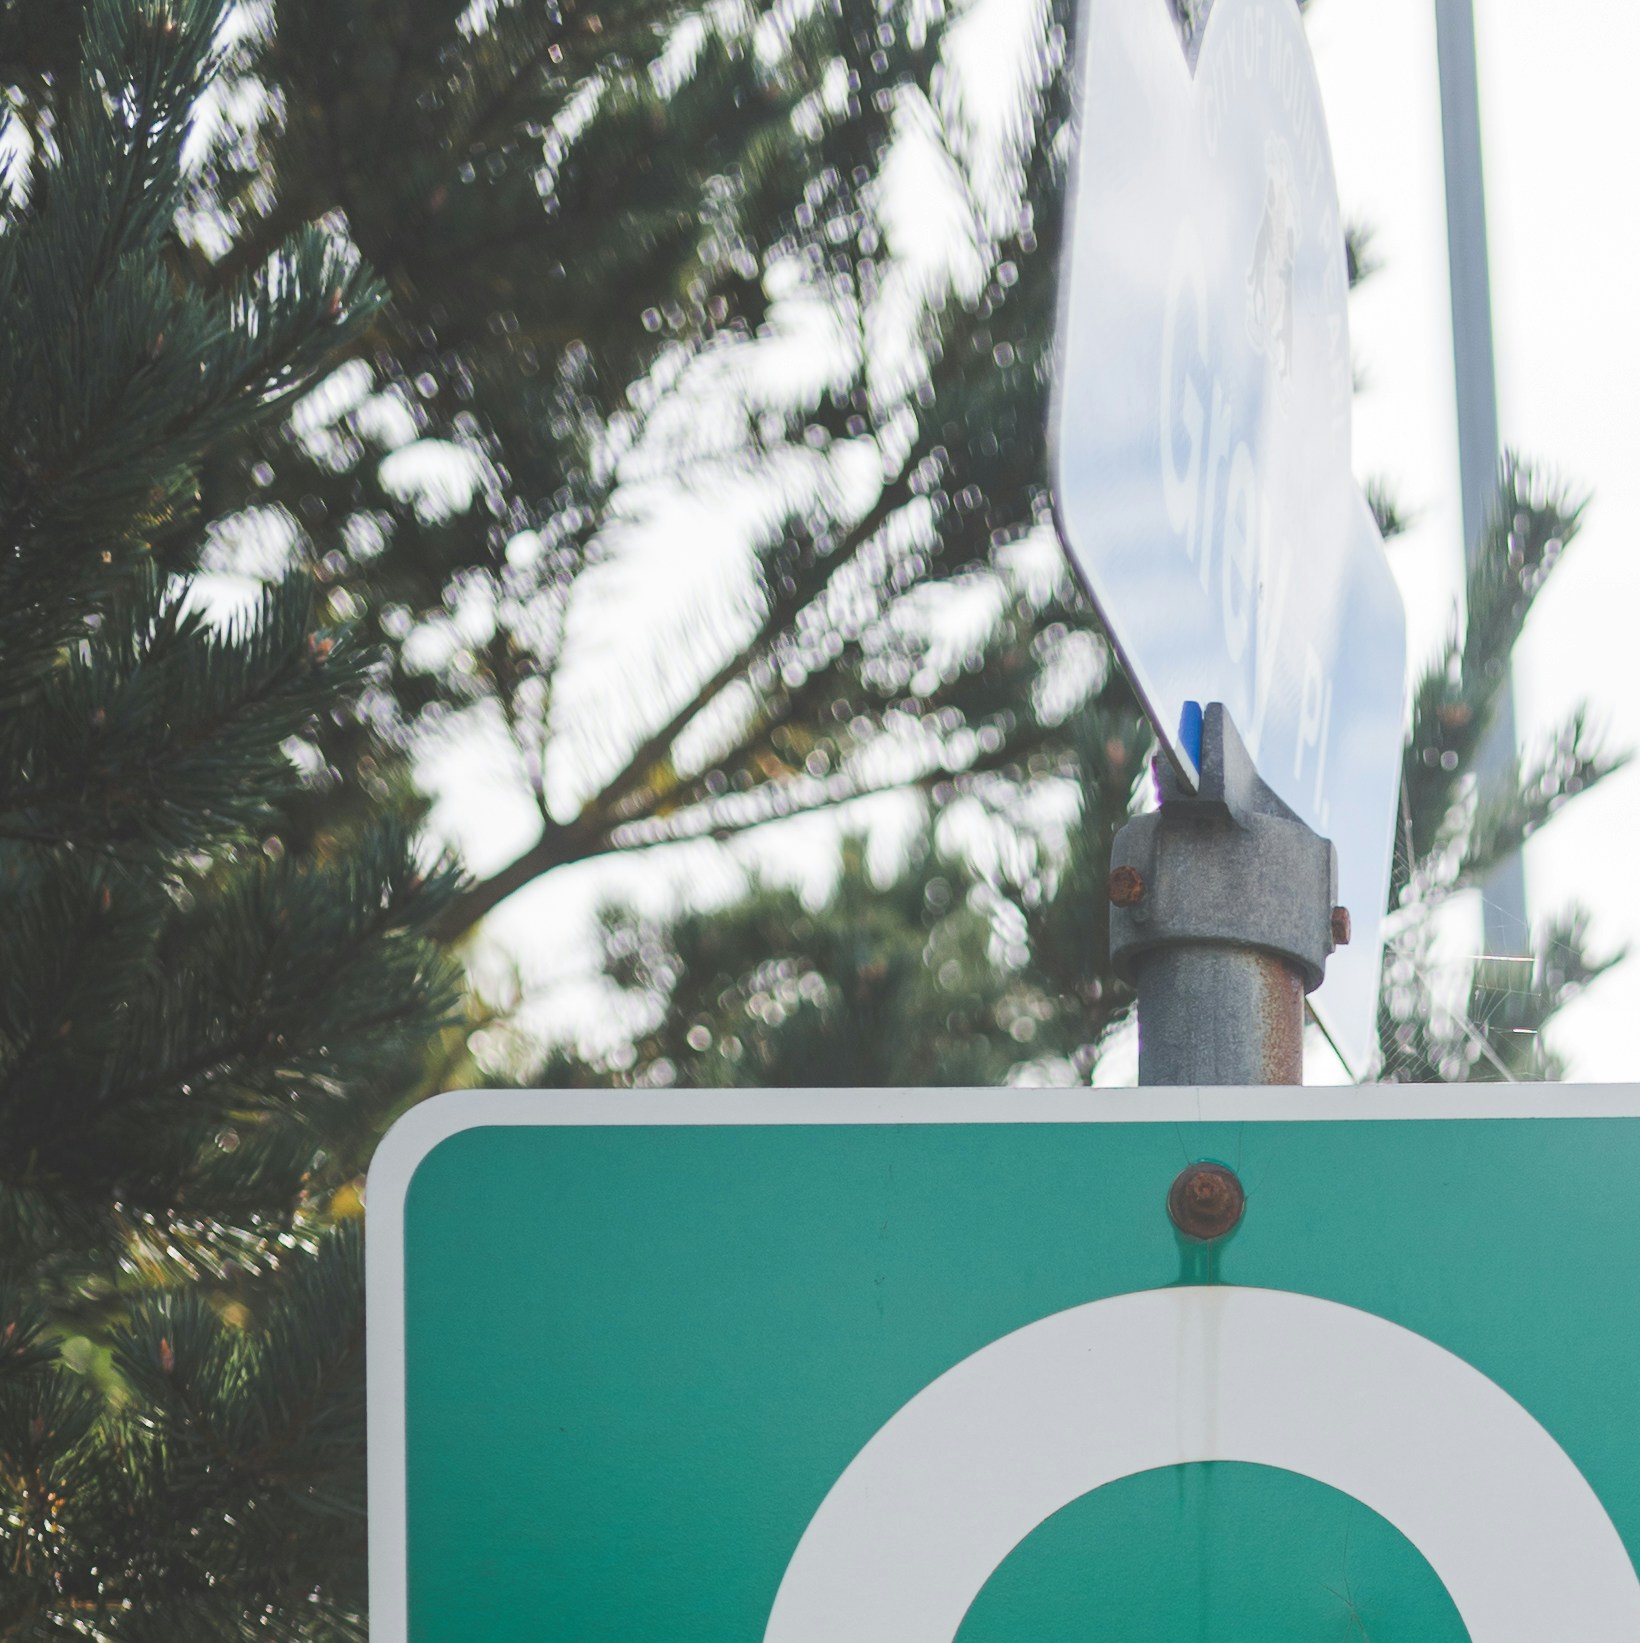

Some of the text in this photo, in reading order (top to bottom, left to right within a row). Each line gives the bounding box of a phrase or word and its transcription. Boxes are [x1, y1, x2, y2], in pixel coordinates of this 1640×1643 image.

[1203, 16, 1236, 159] CITY
[1242, 4, 1265, 80] OF
[1269, 13, 1323, 201] MOUNT
[1160, 213, 1294, 764] Grey
